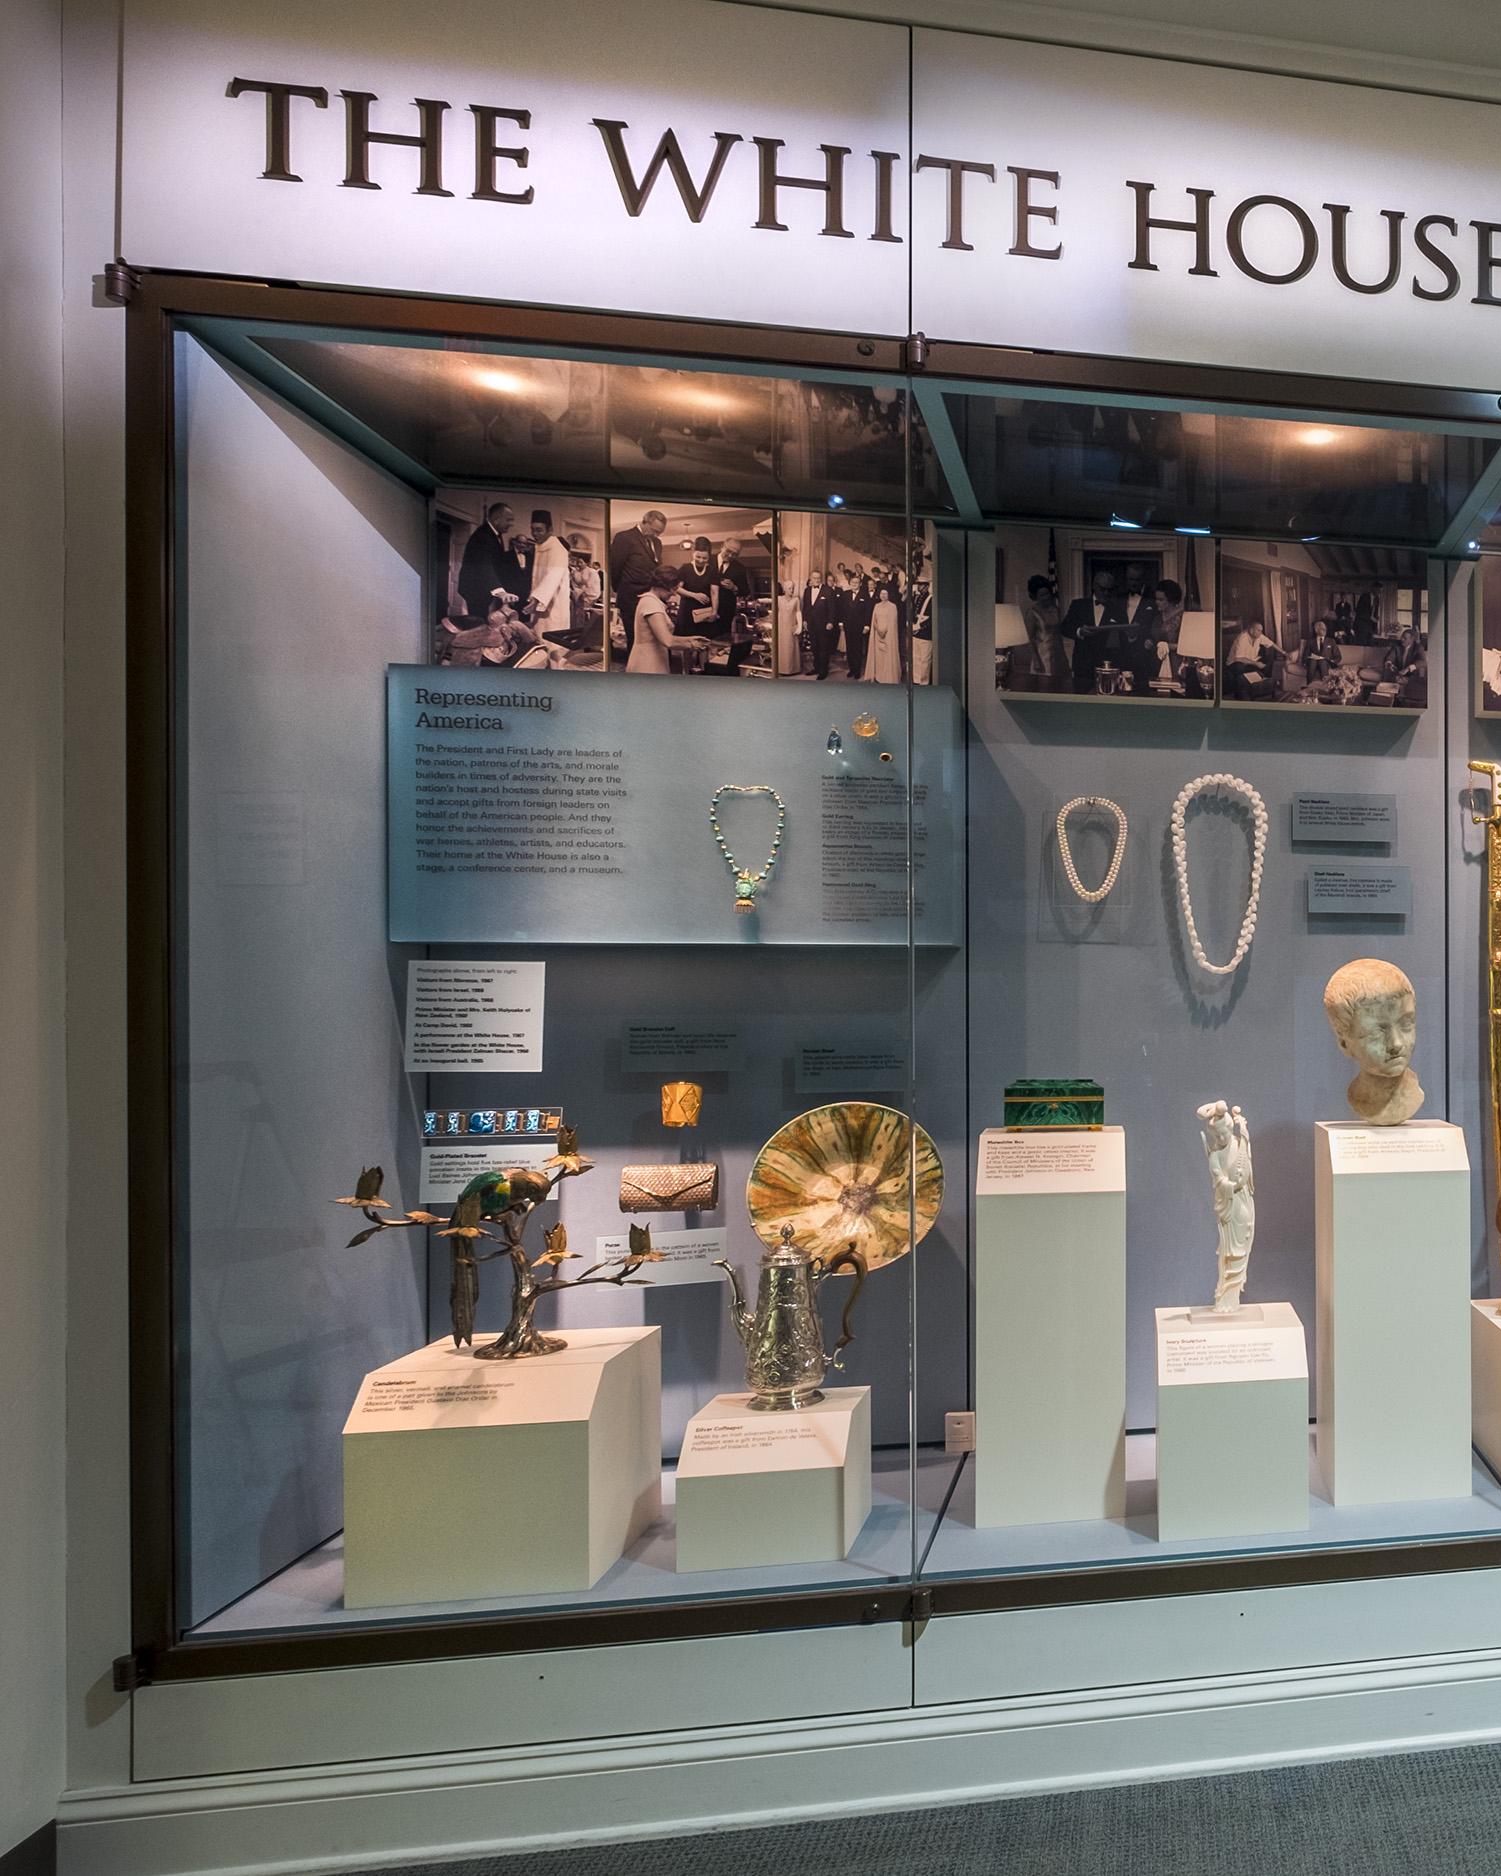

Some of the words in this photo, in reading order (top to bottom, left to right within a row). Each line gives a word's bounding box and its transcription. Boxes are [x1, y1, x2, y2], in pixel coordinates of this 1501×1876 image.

[226, 77, 534, 205] THE
[592, 118, 1063, 260] WHITE
[415, 688, 553, 711] Representing
[415, 712, 504, 730] America
[415, 743, 434, 753] The
[436, 744, 483, 754] President
[485, 746, 504, 754] and
[506, 746, 528, 755] First
[530, 747, 554, 757] Lady
[575, 748, 610, 758] leaders
[612, 749, 622, 758] of
[415, 758, 432, 766] the
[433, 758, 467, 768] nation,
[470, 760, 508, 769] patrons
[510, 760, 520, 768] of
[523, 760, 539, 769] the
[541, 761, 562, 770] arts,
[565, 762, 583, 770] and
[586, 762, 619, 771] morale
[415, 771, 455, 780] builders
[458, 772, 467, 780] in
[470, 772, 497, 780] times
[500, 773, 510, 781] of
[512, 773, 559, 783] adversity.
[561, 774, 586, 784] They
[606, 775, 622, 784] the
[415, 784, 454, 792] nation's
[456, 785, 478, 793] host
[480, 786, 499, 794] and
[502, 786, 539, 795] hostess
[542, 787, 574, 797] during
[576, 788, 600, 796] state
[602, 788, 627, 797] visits
[415, 797, 434, 805] and
[437, 799, 469, 808] accept
[472, 798, 494, 808] gifts
[497, 799, 520, 807] from
[523, 800, 557, 809] foreign
[560, 800, 594, 809] leaders
[415, 810, 447, 819] behalf
[449, 811, 460, 819] of
[462, 811, 478, 819] the
[480, 812, 527, 820] American
[530, 813, 564, 822] people.
[567, 813, 588, 822] And
[591, 813, 612, 823] they
[415, 824, 446, 832] honor
[448, 824, 464, 832] the
[466, 825, 534, 833] achievements
[536, 826, 554, 834] and
[557, 827, 602, 835] sacrifices
[605, 827, 615, 835] of
[437, 837, 473, 846] heroes,
[476, 838, 517, 847] athletes,
[519, 839, 552, 848] artists,
[555, 839, 573, 848] and
[576, 840, 626, 849] educators.
[415, 849, 442, 858] Their
[443, 850, 473, 859] home
[475, 851, 485, 859] at
[487, 851, 503, 859] the
[505, 851, 534, 860] White
[537, 852, 568, 860] House
[581, 852, 600, 861] also
[415, 864, 446, 873] stage,
[457, 863, 511, 872] conference
[513, 865, 546, 874] center,
[549, 865, 567, 873] and
